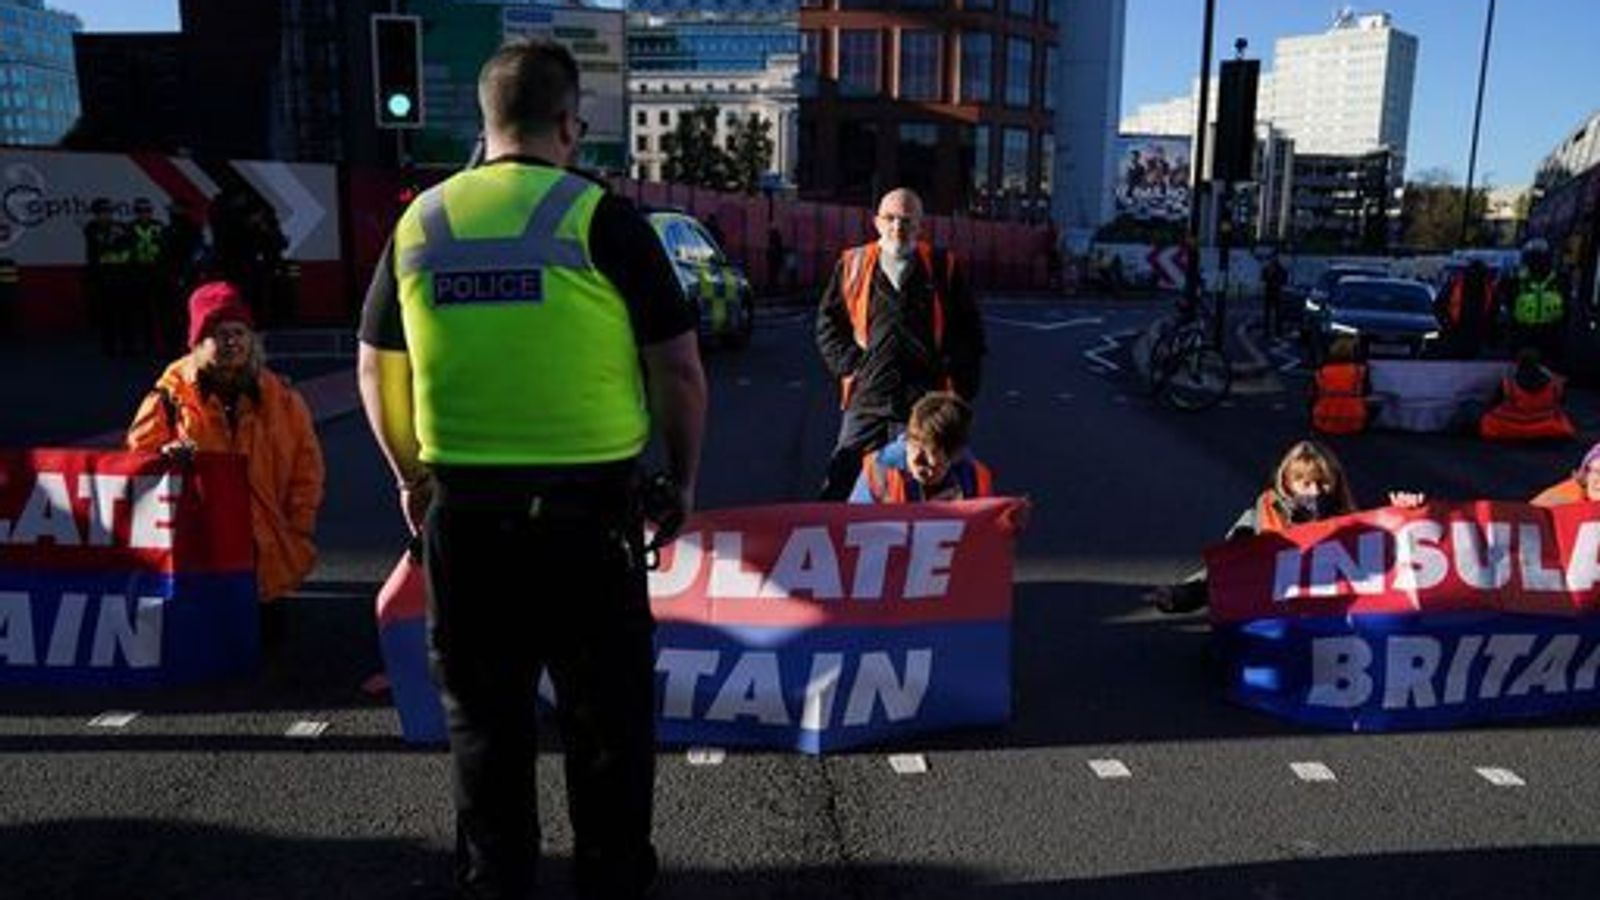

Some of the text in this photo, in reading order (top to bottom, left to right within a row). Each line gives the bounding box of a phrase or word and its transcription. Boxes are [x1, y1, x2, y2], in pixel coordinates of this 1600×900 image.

[437, 273, 537, 299] POLICE
[645, 519, 965, 599] ULATE
[655, 648, 933, 731] TAIN
